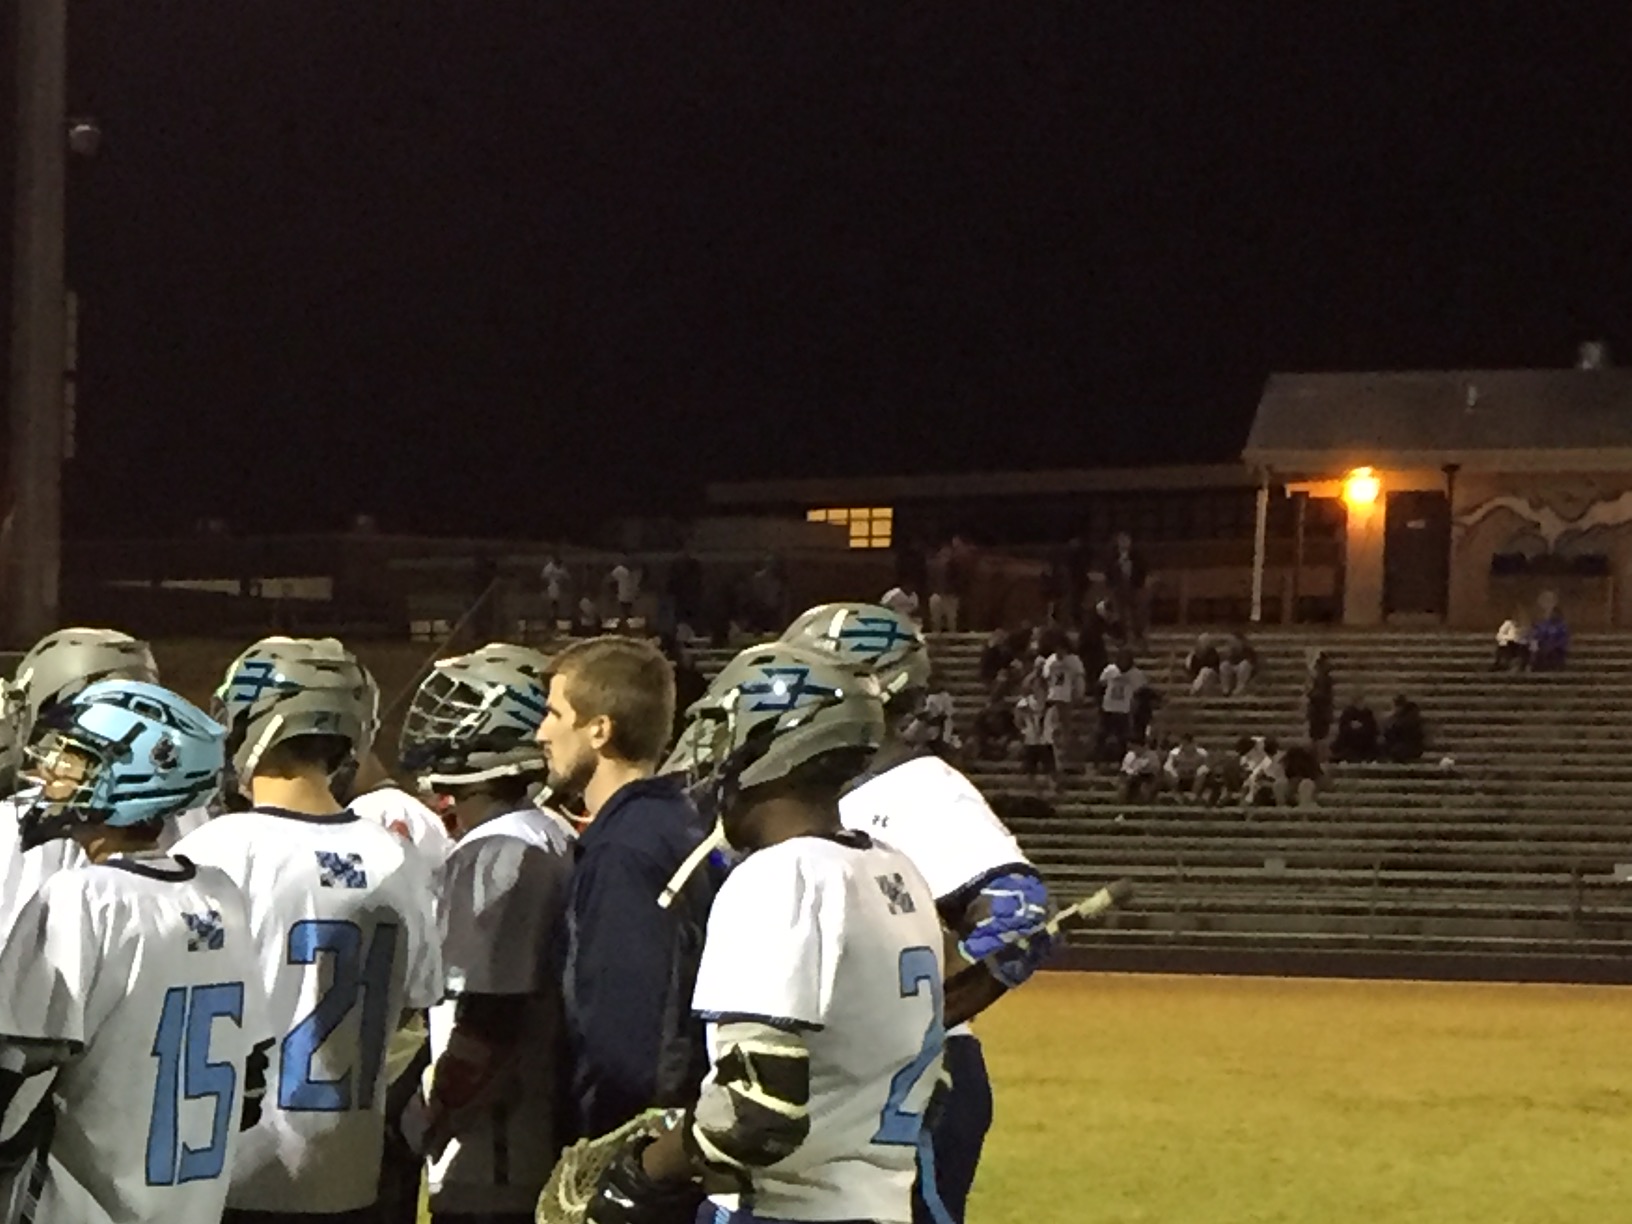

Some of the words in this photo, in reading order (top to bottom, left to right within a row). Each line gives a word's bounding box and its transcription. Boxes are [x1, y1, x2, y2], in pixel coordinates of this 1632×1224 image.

[145, 982, 244, 1186] 15
[277, 920, 398, 1110] 21
[870, 946, 945, 1145] 2
